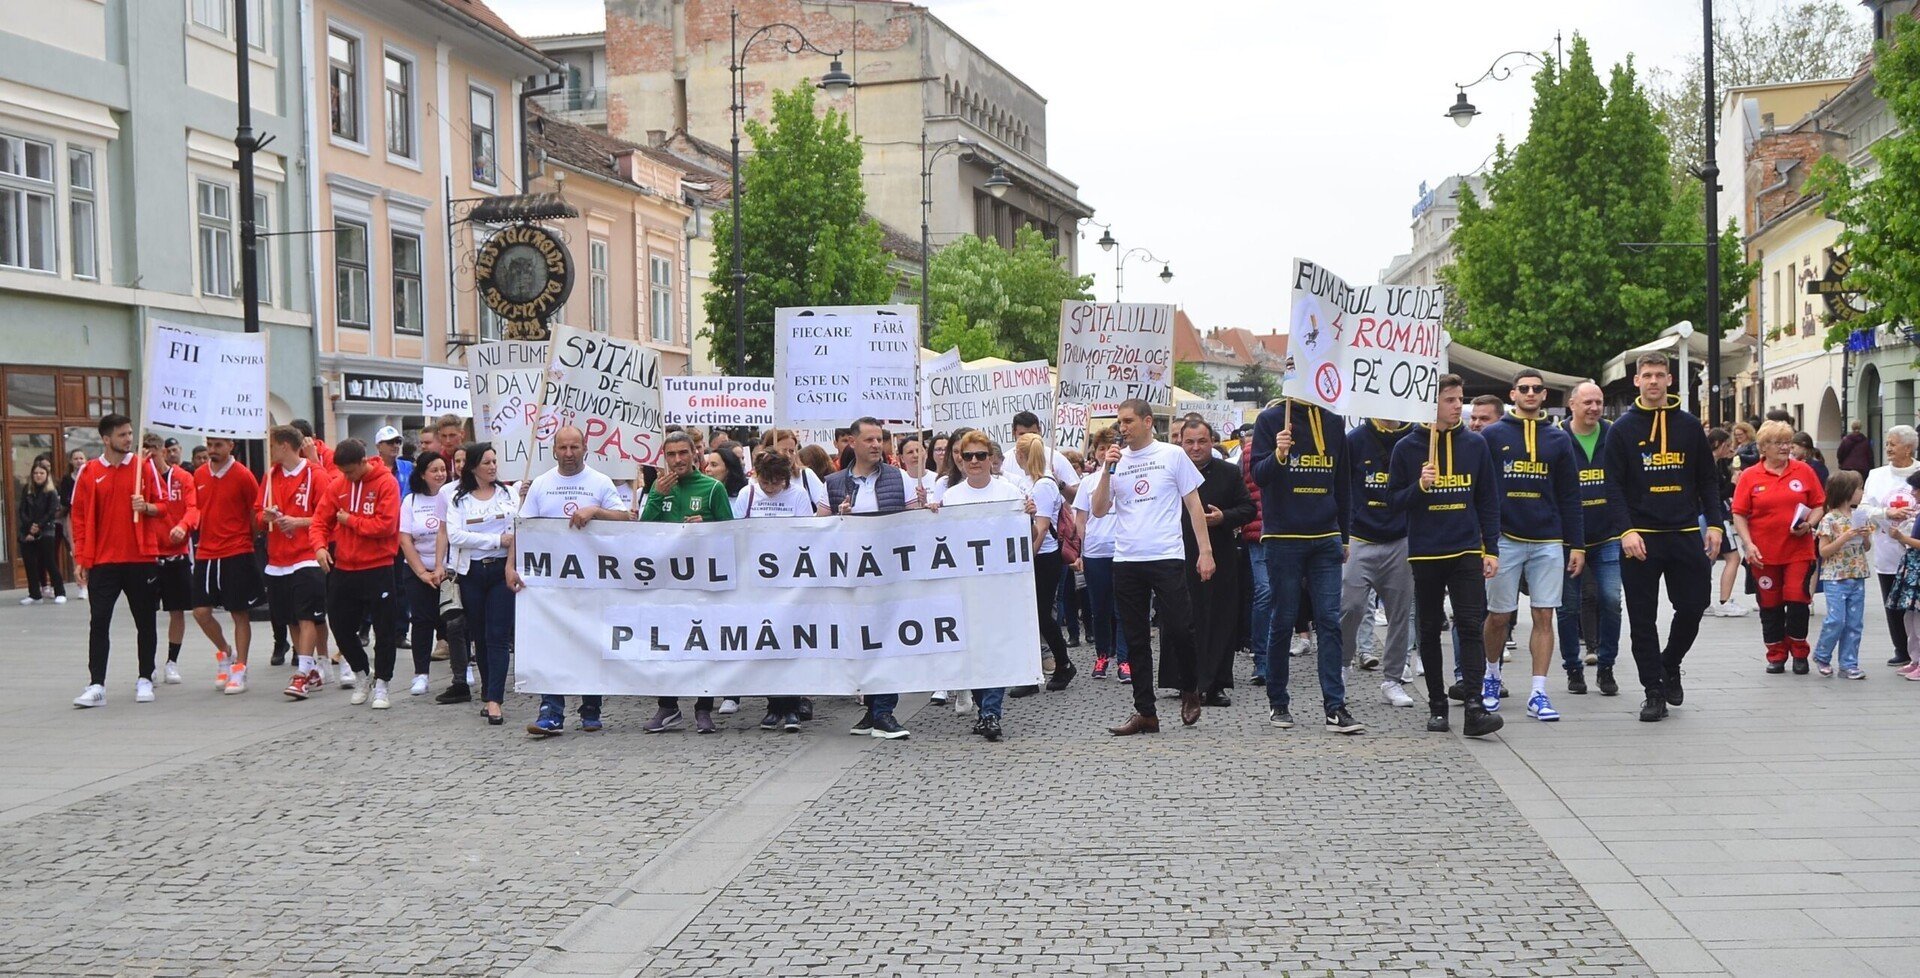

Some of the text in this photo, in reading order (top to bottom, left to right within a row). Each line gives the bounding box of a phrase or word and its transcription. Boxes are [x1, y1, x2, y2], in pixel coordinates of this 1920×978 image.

[1294, 260, 1444, 320] FUMATUL UCIDE
[1070, 303, 1169, 335] SPITALULUI
[792, 327, 853, 338] FIECARE
[873, 320, 905, 334] FĂRĂ
[1331, 312, 1344, 341] 4
[1100, 334, 1112, 344] DE
[169, 341, 200, 364] FII
[814, 345, 828, 355] ZI
[869, 341, 908, 352] TUTUN
[478, 346, 500, 368] NU
[598, 374, 623, 394] DE
[665, 378, 723, 391] Tutunul
[794, 375, 850, 386] ESTE UN
[870, 377, 909, 387] PENTRU
[931, 365, 1051, 397] CANCERUL PULMONAR
[1351, 356, 1438, 404] PE ORĂ
[164, 386, 196, 399] NU TE
[363, 379, 390, 399] LAS
[237, 394, 252, 403] DE
[426, 394, 468, 412] Spune
[688, 394, 767, 408] 6 milioane
[160, 400, 198, 414] APUCA
[221, 407, 263, 417] FUMAT!
[934, 401, 961, 422] ESTE
[962, 401, 980, 420] CEL
[491, 396, 521, 435] STOP
[664, 411, 681, 424] de
[686, 410, 741, 424] victime
[802, 429, 809, 442] 7
[505, 439, 528, 463] LA
[1301, 455, 1333, 467] SIBIU
[1652, 453, 1685, 465] SIBIU
[1514, 461, 1548, 474] SIBIU
[1434, 474, 1471, 487] SIBIU
[171, 490, 182, 501] 51
[662, 501, 672, 512] 29
[524, 535, 1030, 586] MARȘUL SĂNĂTĂȚII
[612, 616, 960, 651] PLĂMÂNILOR
